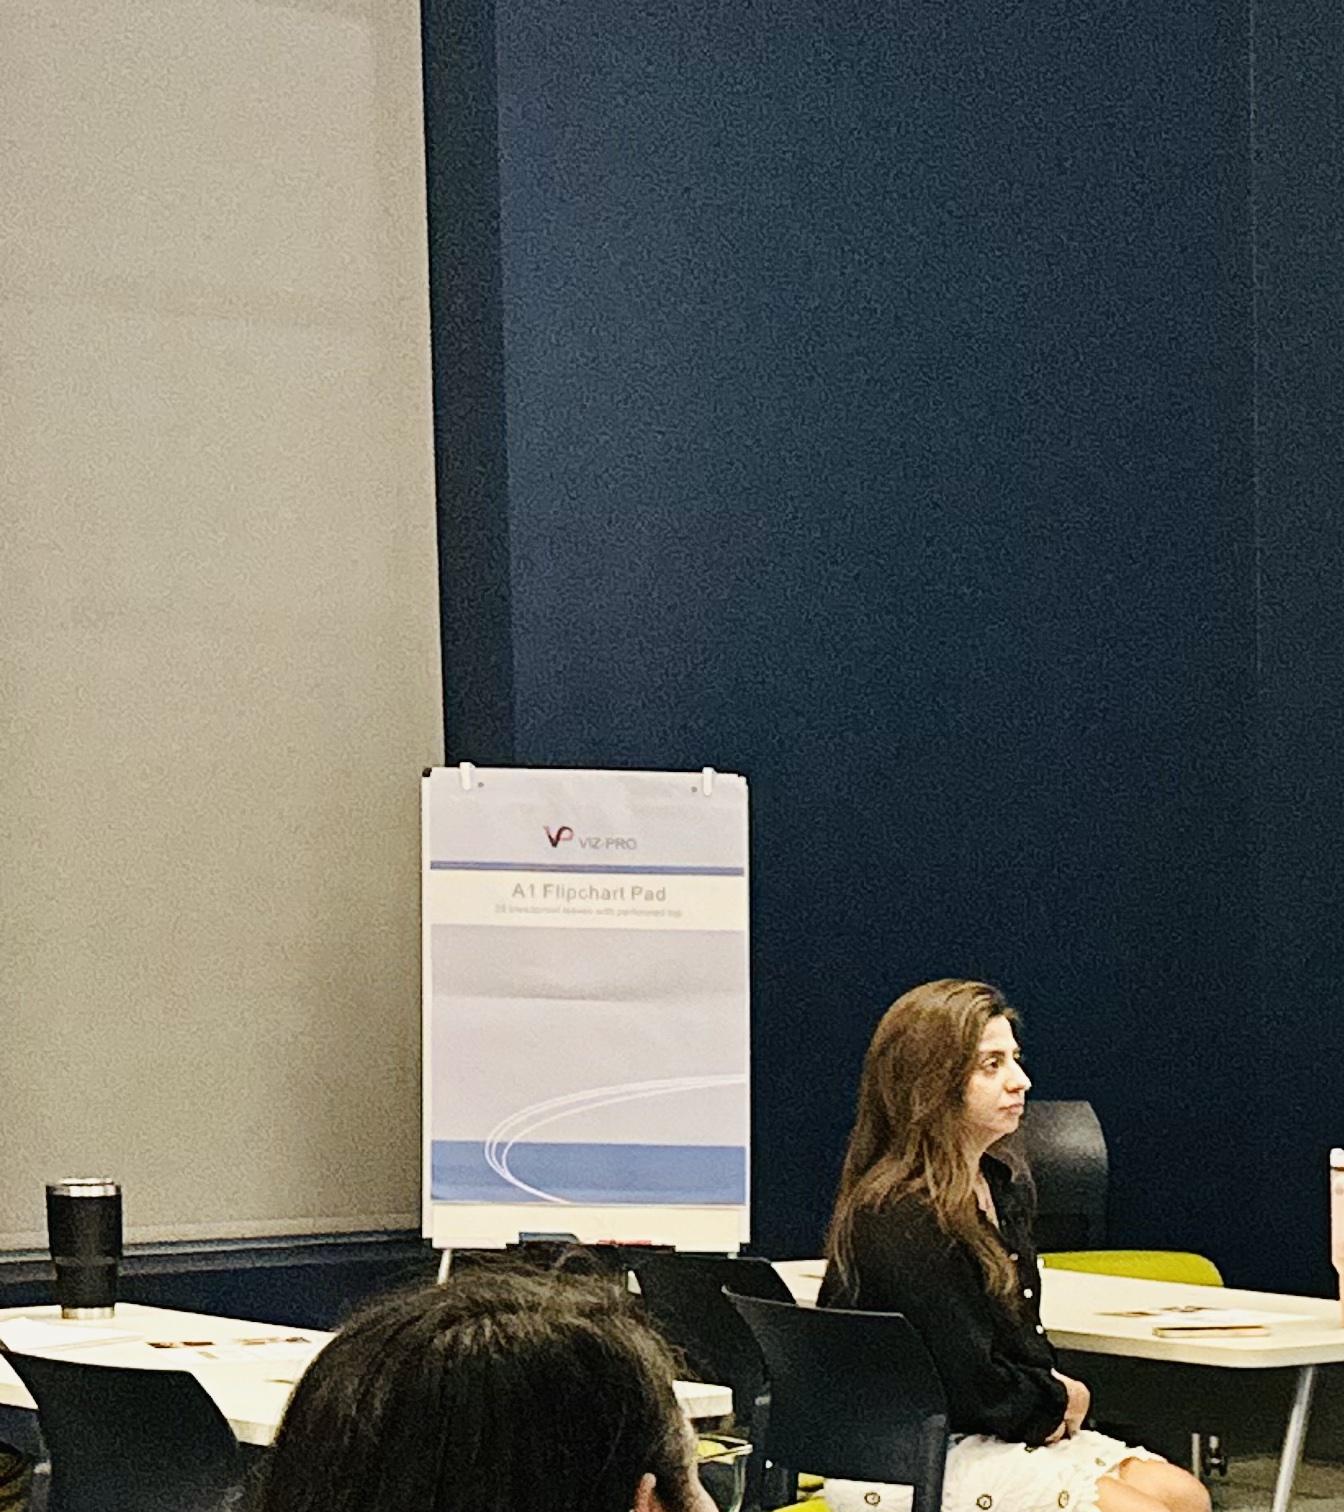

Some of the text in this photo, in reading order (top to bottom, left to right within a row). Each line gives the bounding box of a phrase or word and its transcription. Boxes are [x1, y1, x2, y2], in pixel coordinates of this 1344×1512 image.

[512, 883, 667, 902] A1 Flipchart Pad
